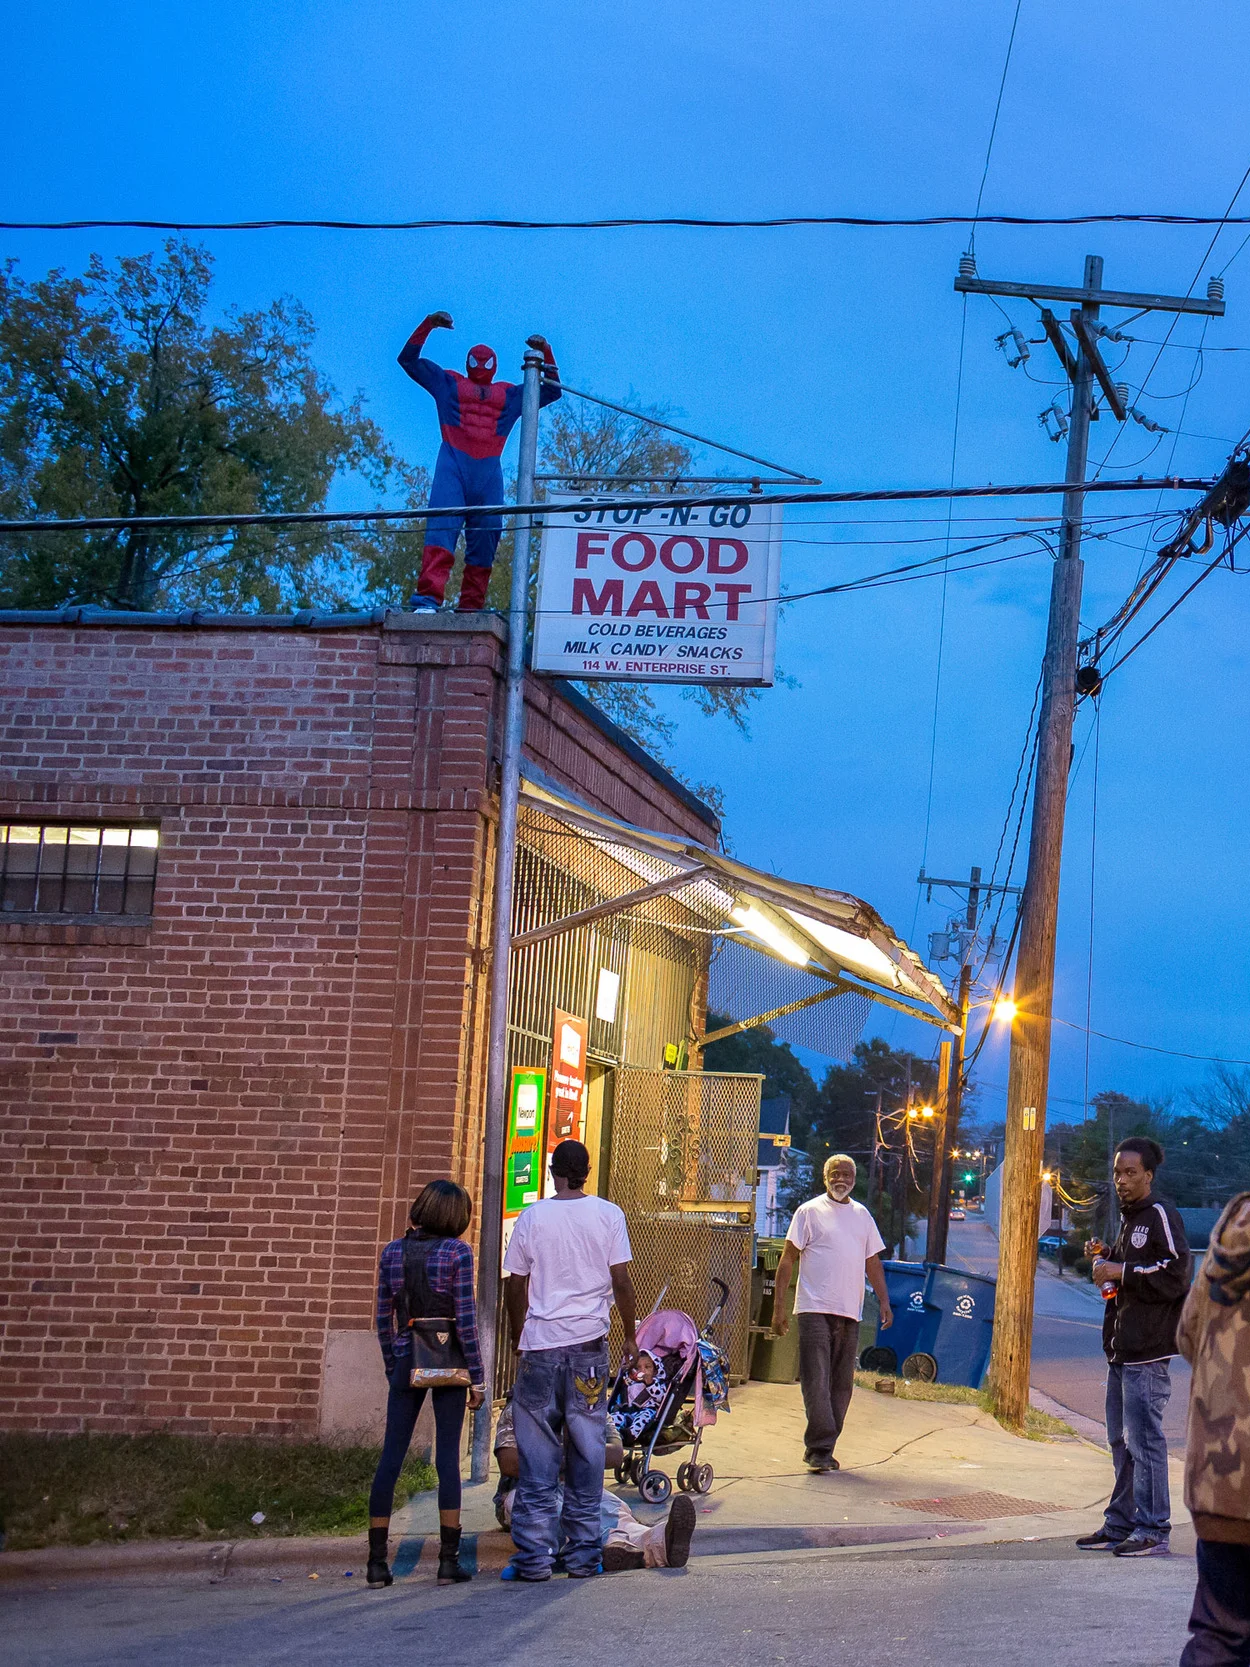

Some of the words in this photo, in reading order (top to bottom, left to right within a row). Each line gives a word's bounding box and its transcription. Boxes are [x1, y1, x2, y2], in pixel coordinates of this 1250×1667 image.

[574, 498, 652, 524] STOP
[709, 503, 752, 528] GO
[575, 532, 749, 574] FOOD
[571, 578, 752, 621] MART
[588, 623, 631, 636] COLD
[635, 625, 728, 640] BEVERAGES
[563, 641, 602, 655] MILK
[610, 642, 669, 657] CANDY
[676, 645, 744, 660] SNACKS
[582, 660, 600, 671] 114
[605, 661, 622, 672] W.
[625, 662, 706, 675] ENTERPRISE
[710, 665, 731, 676] ST.
[518, 1106, 535, 1120] Newport
